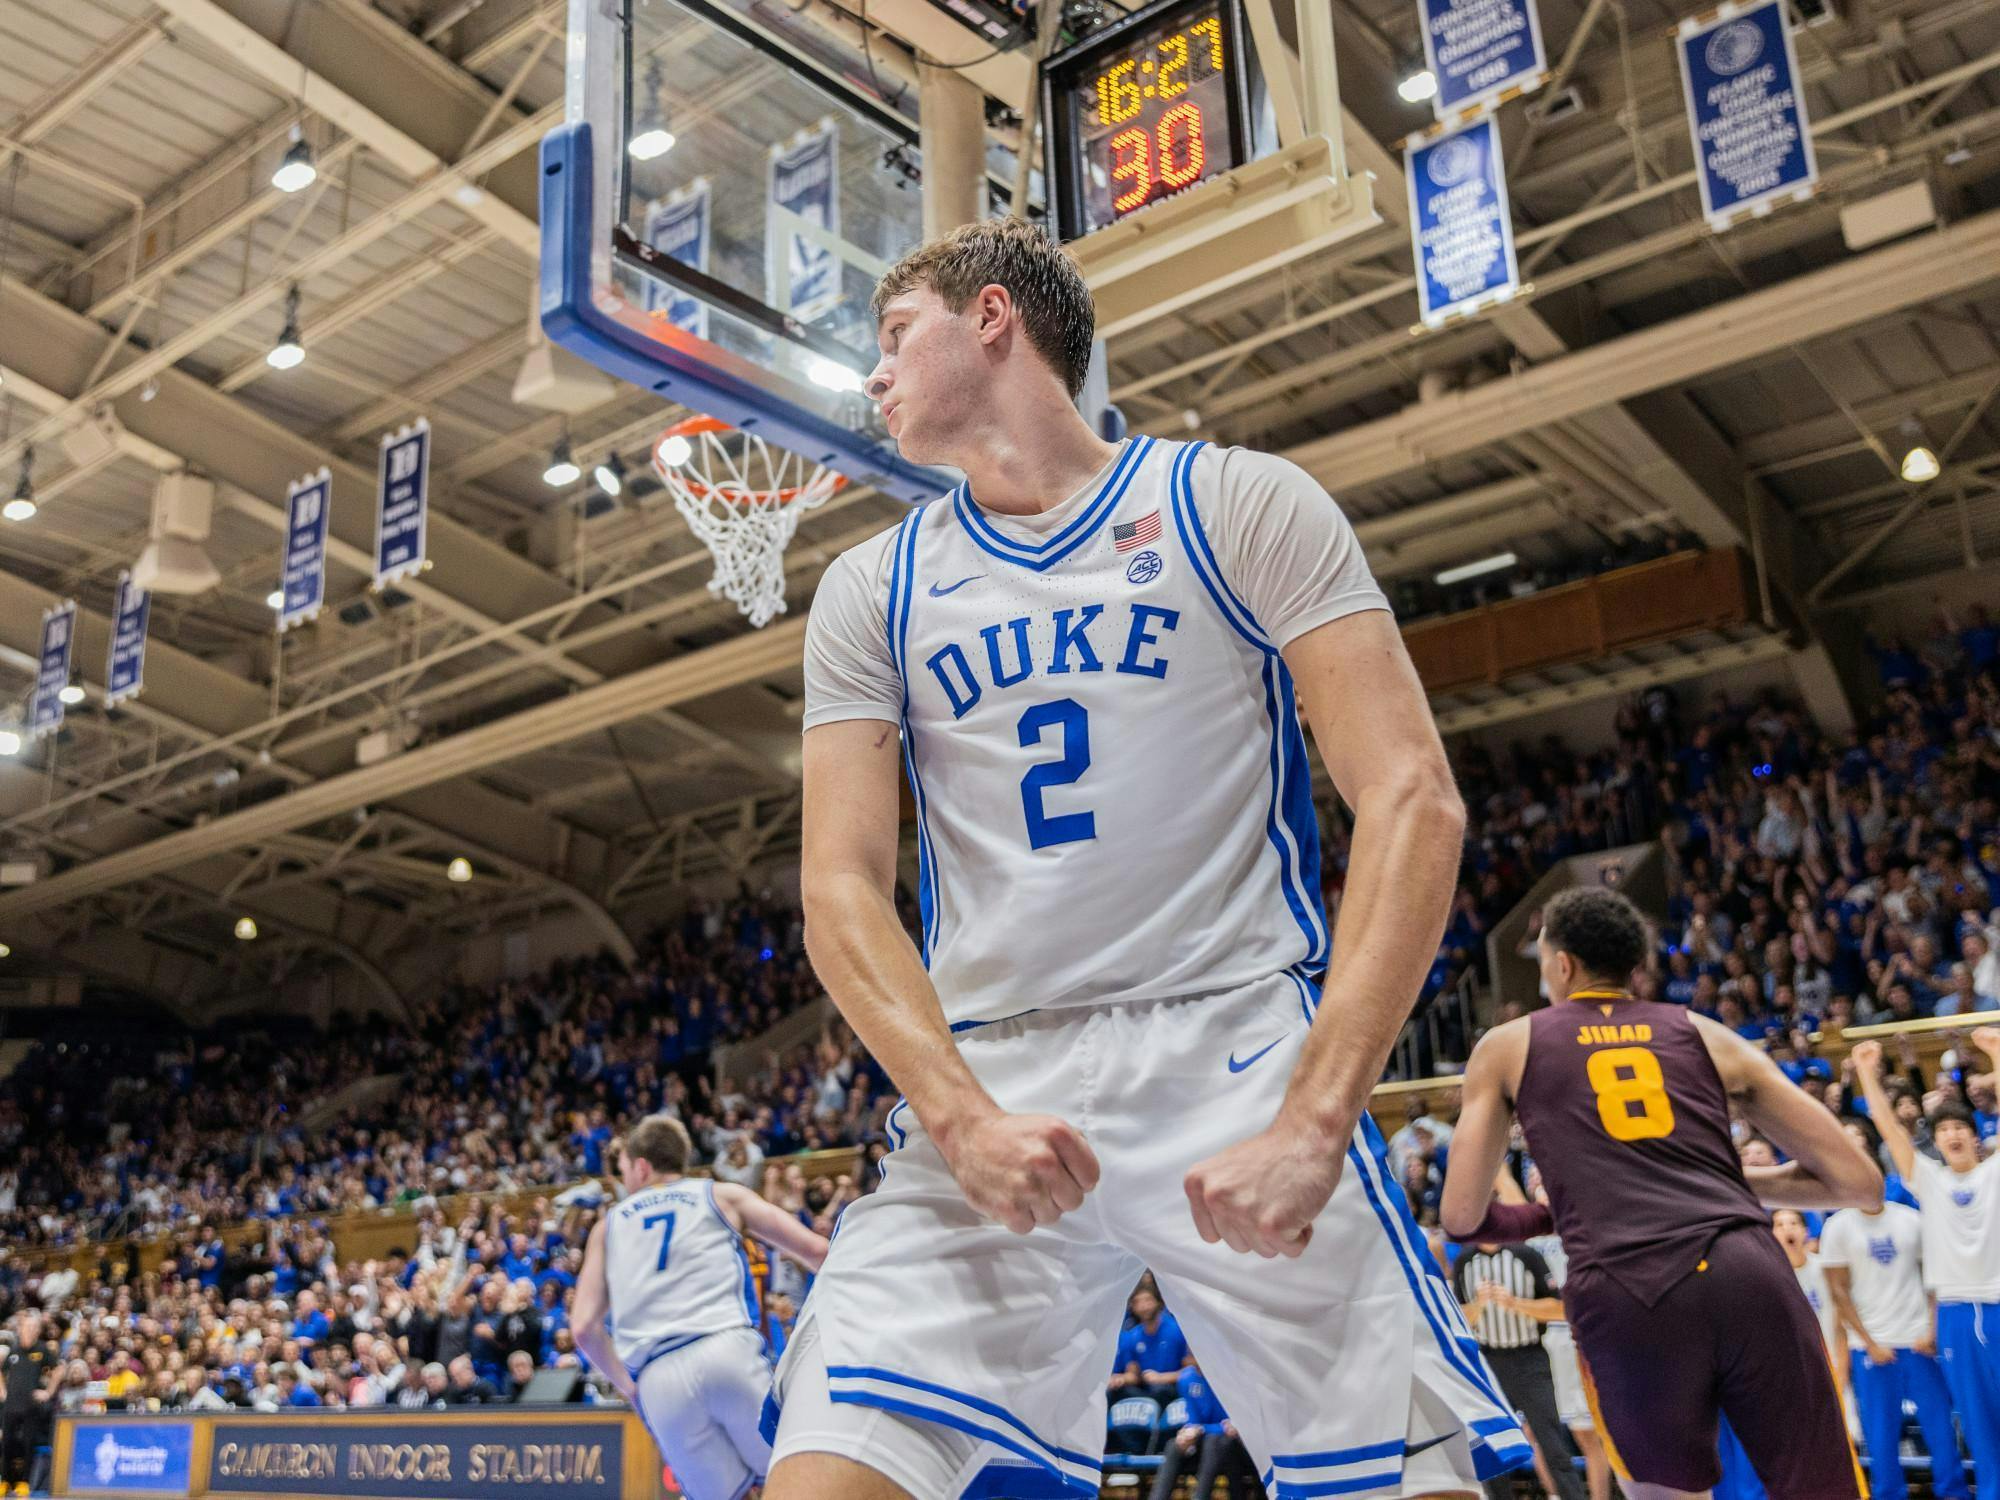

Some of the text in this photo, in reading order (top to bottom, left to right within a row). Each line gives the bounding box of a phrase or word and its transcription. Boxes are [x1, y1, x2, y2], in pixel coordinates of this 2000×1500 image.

[1097, 18, 1223, 125] 16:27
[1112, 102, 1204, 211] 30
[1131, 558, 1158, 574] ACC
[925, 603, 1181, 720] DUKE
[1016, 697, 1097, 851] 2
[1576, 1024, 1653, 1046] JIHAD
[1586, 1046, 1676, 1142] 8
[643, 1211, 676, 1271] 7
[218, 1442, 605, 1485] CAMERON INDOOR STADIUM
